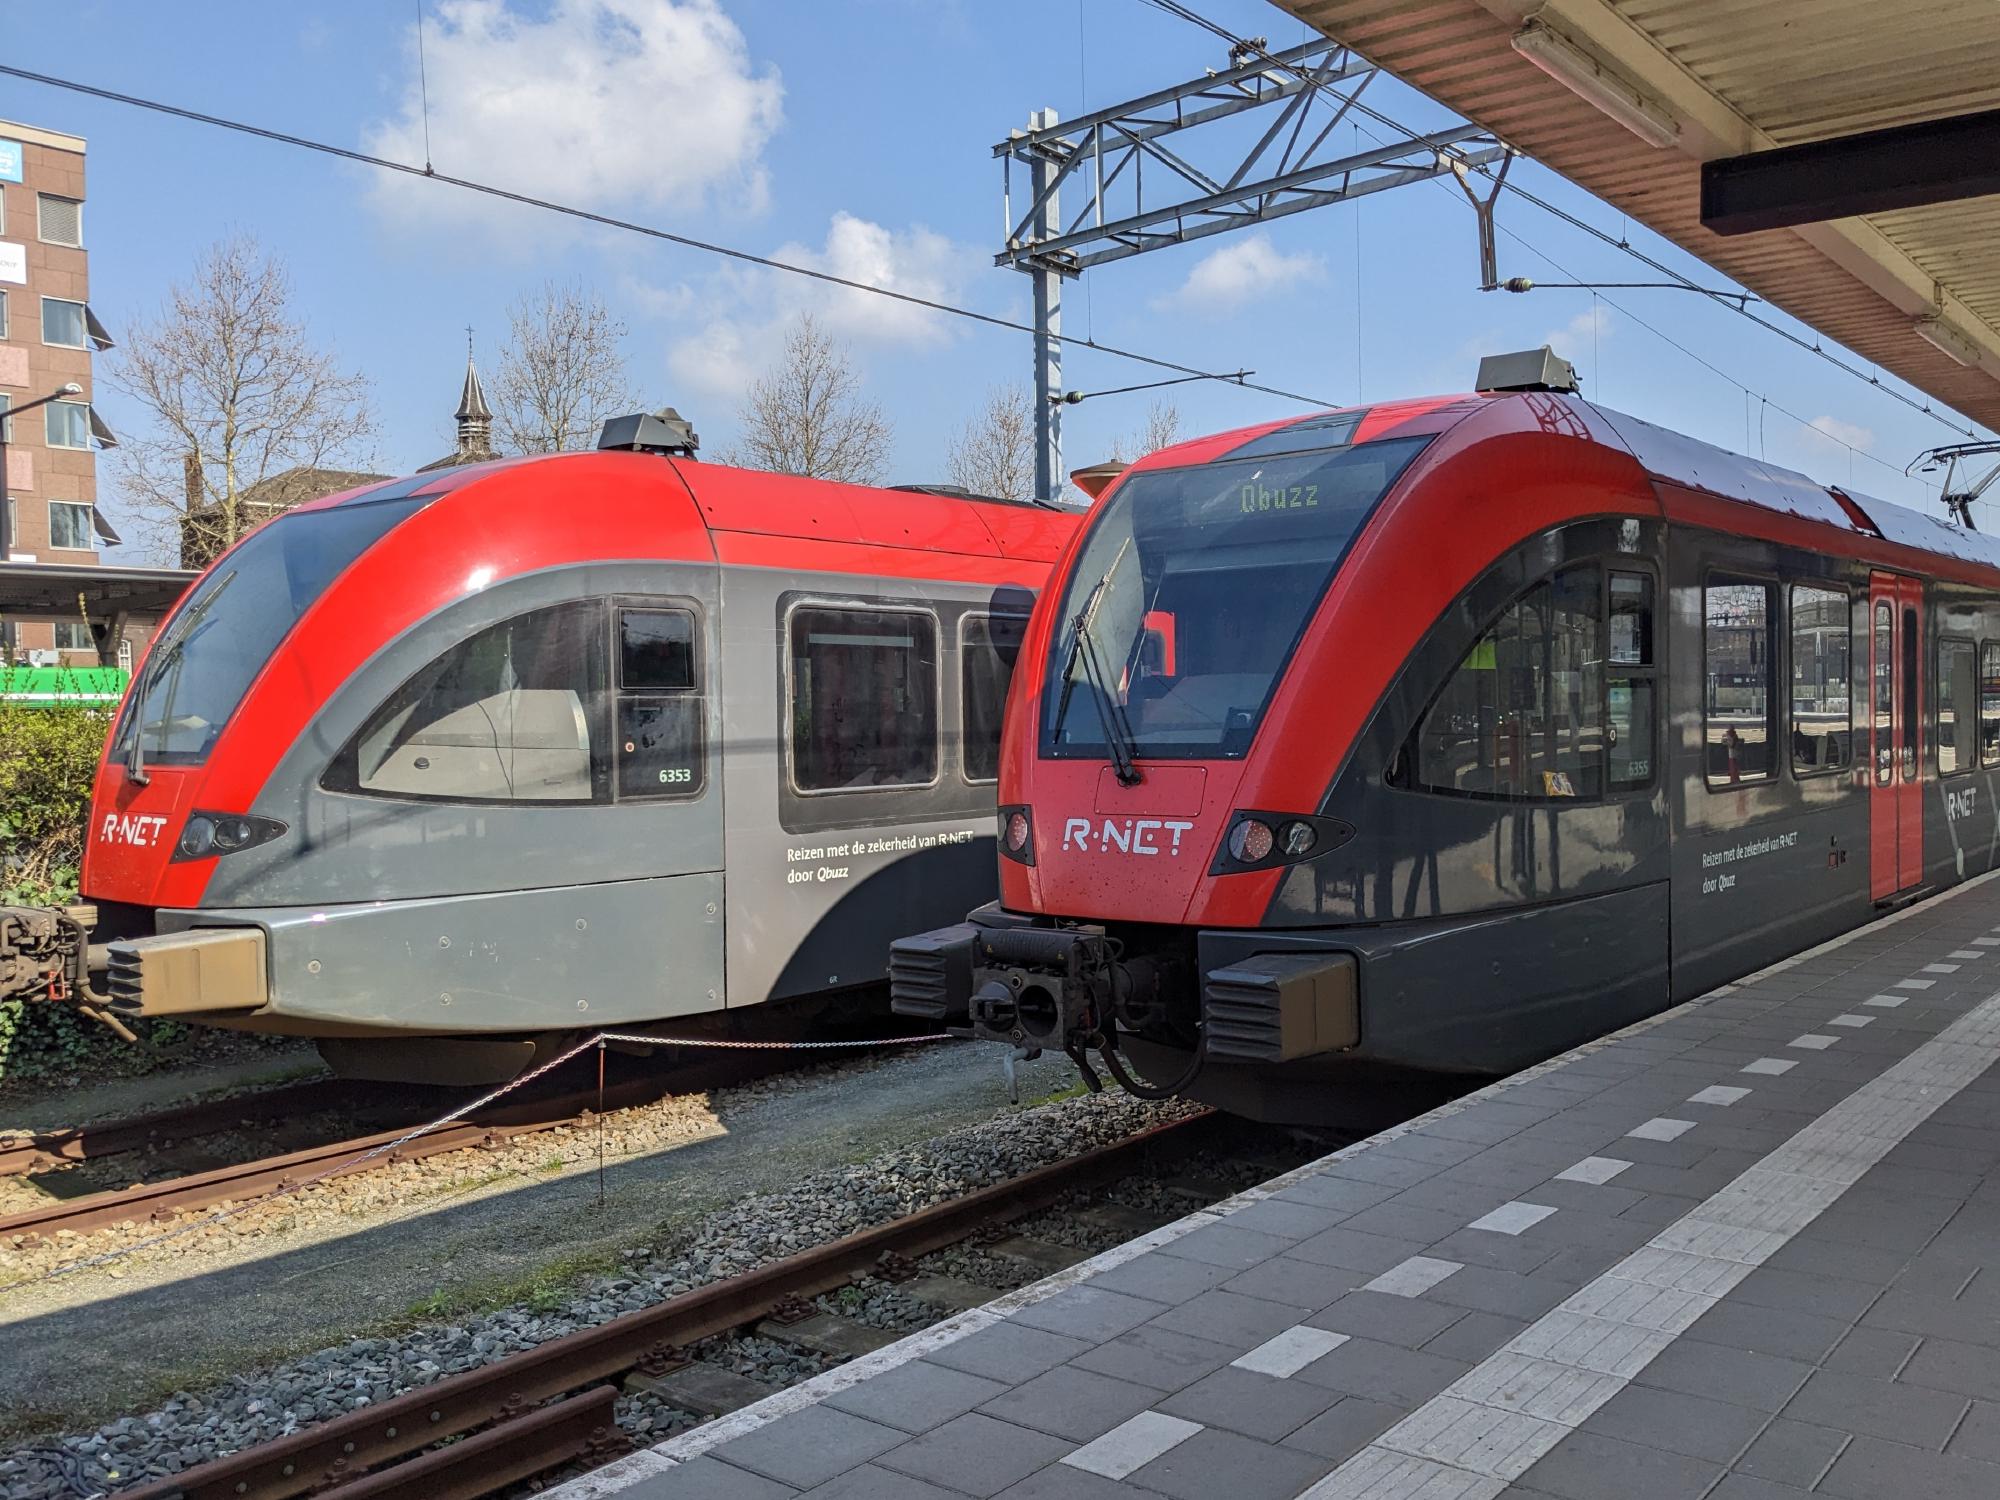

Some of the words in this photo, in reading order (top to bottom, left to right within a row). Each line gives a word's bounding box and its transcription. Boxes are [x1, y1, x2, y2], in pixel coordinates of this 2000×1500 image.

[1240, 483, 1318, 512] Qbuzz
[659, 768, 691, 783] 6353
[1629, 760, 1649, 777] 6355
[787, 848, 824, 862] Reizen
[826, 844, 849, 858] met
[852, 841, 865, 855] de
[867, 836, 917, 854] zekerheid
[918, 836, 936, 848] van
[1702, 851, 1722, 868] Reizen
[1723, 848, 1736, 863] met
[1735, 843, 1744, 860] de
[1744, 837, 1769, 858] zekerheid
[1770, 839, 1779, 852] van
[787, 869, 814, 884] door
[817, 867, 849, 882] Qbuzz
[1702, 876, 1717, 894] door
[1718, 874, 1736, 892] Qbuzz
